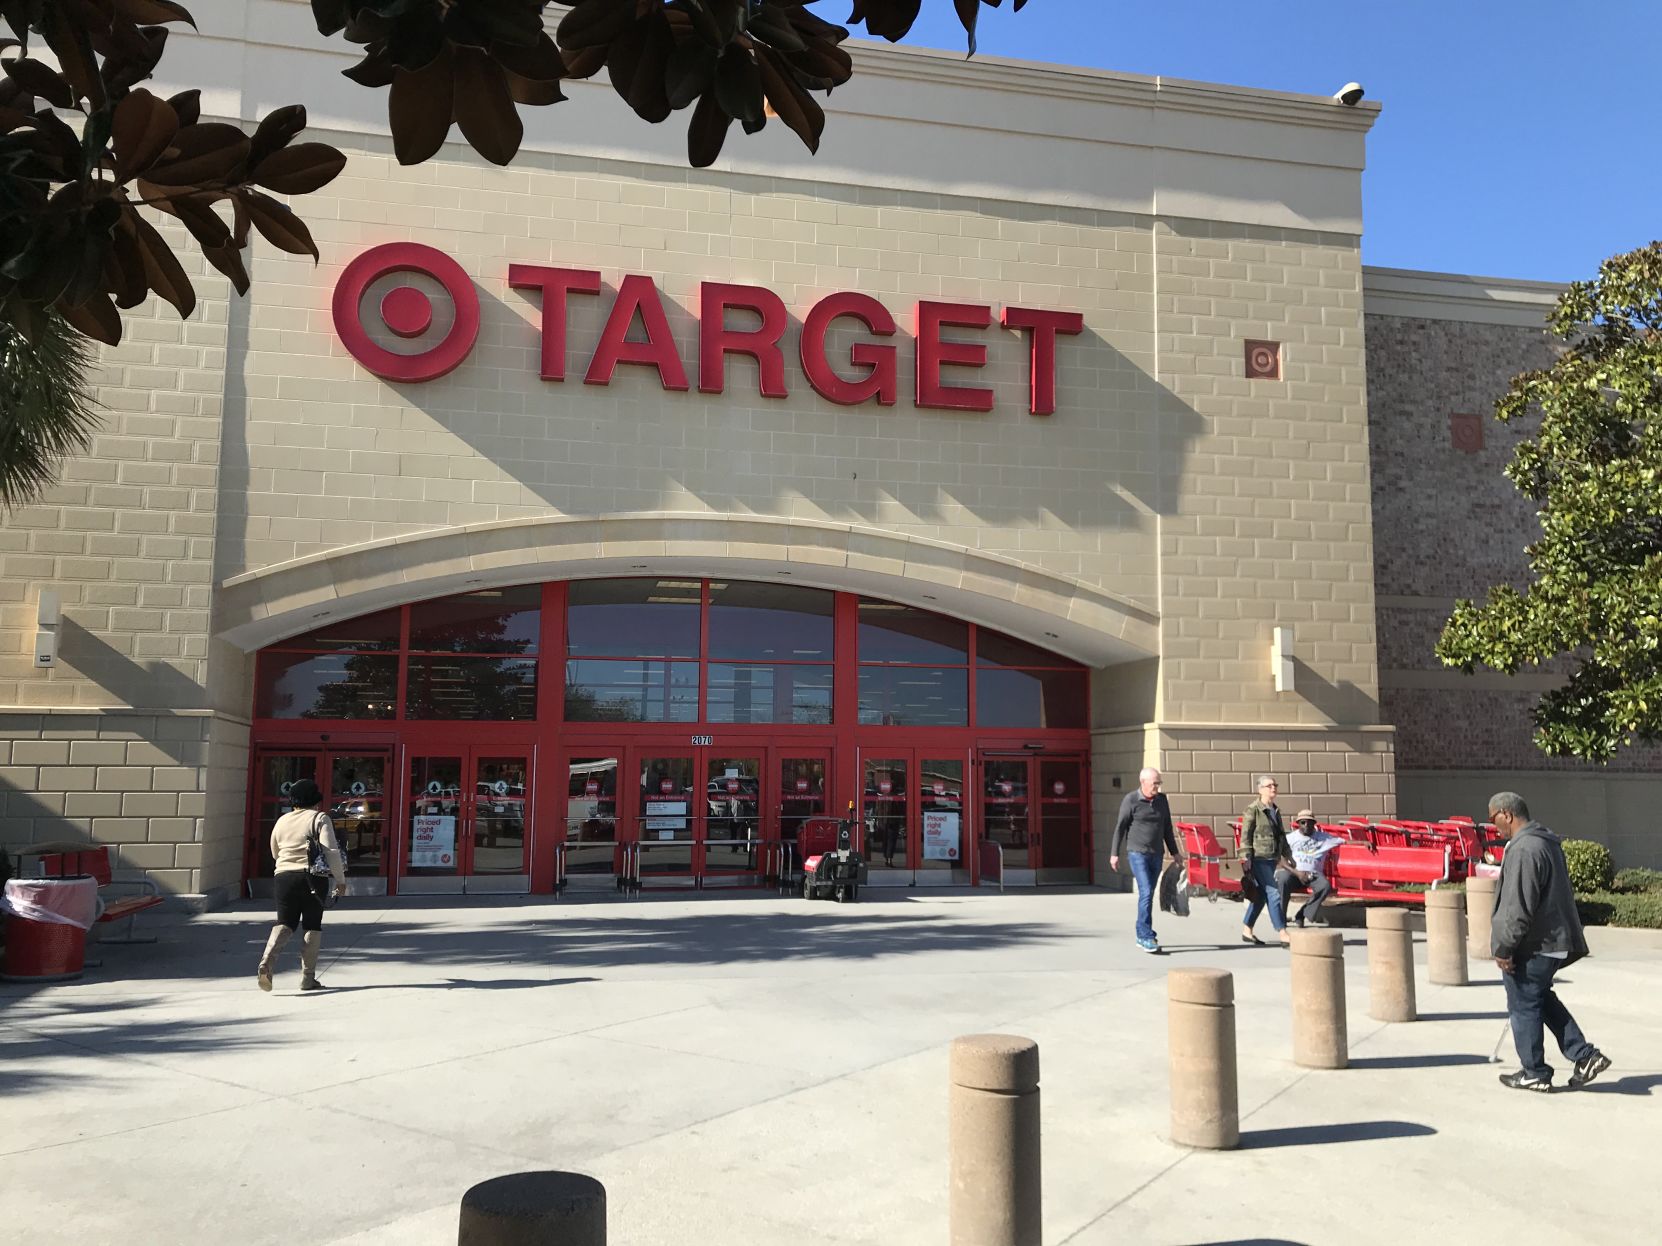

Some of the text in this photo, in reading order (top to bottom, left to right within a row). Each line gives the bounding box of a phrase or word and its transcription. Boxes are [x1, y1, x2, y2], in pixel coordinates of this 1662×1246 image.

[508, 263, 1083, 416] TARGET
[692, 736, 712, 745] 2070
[417, 818, 441, 826] Priced
[416, 826, 434, 834] right
[416, 834, 434, 842] daily
